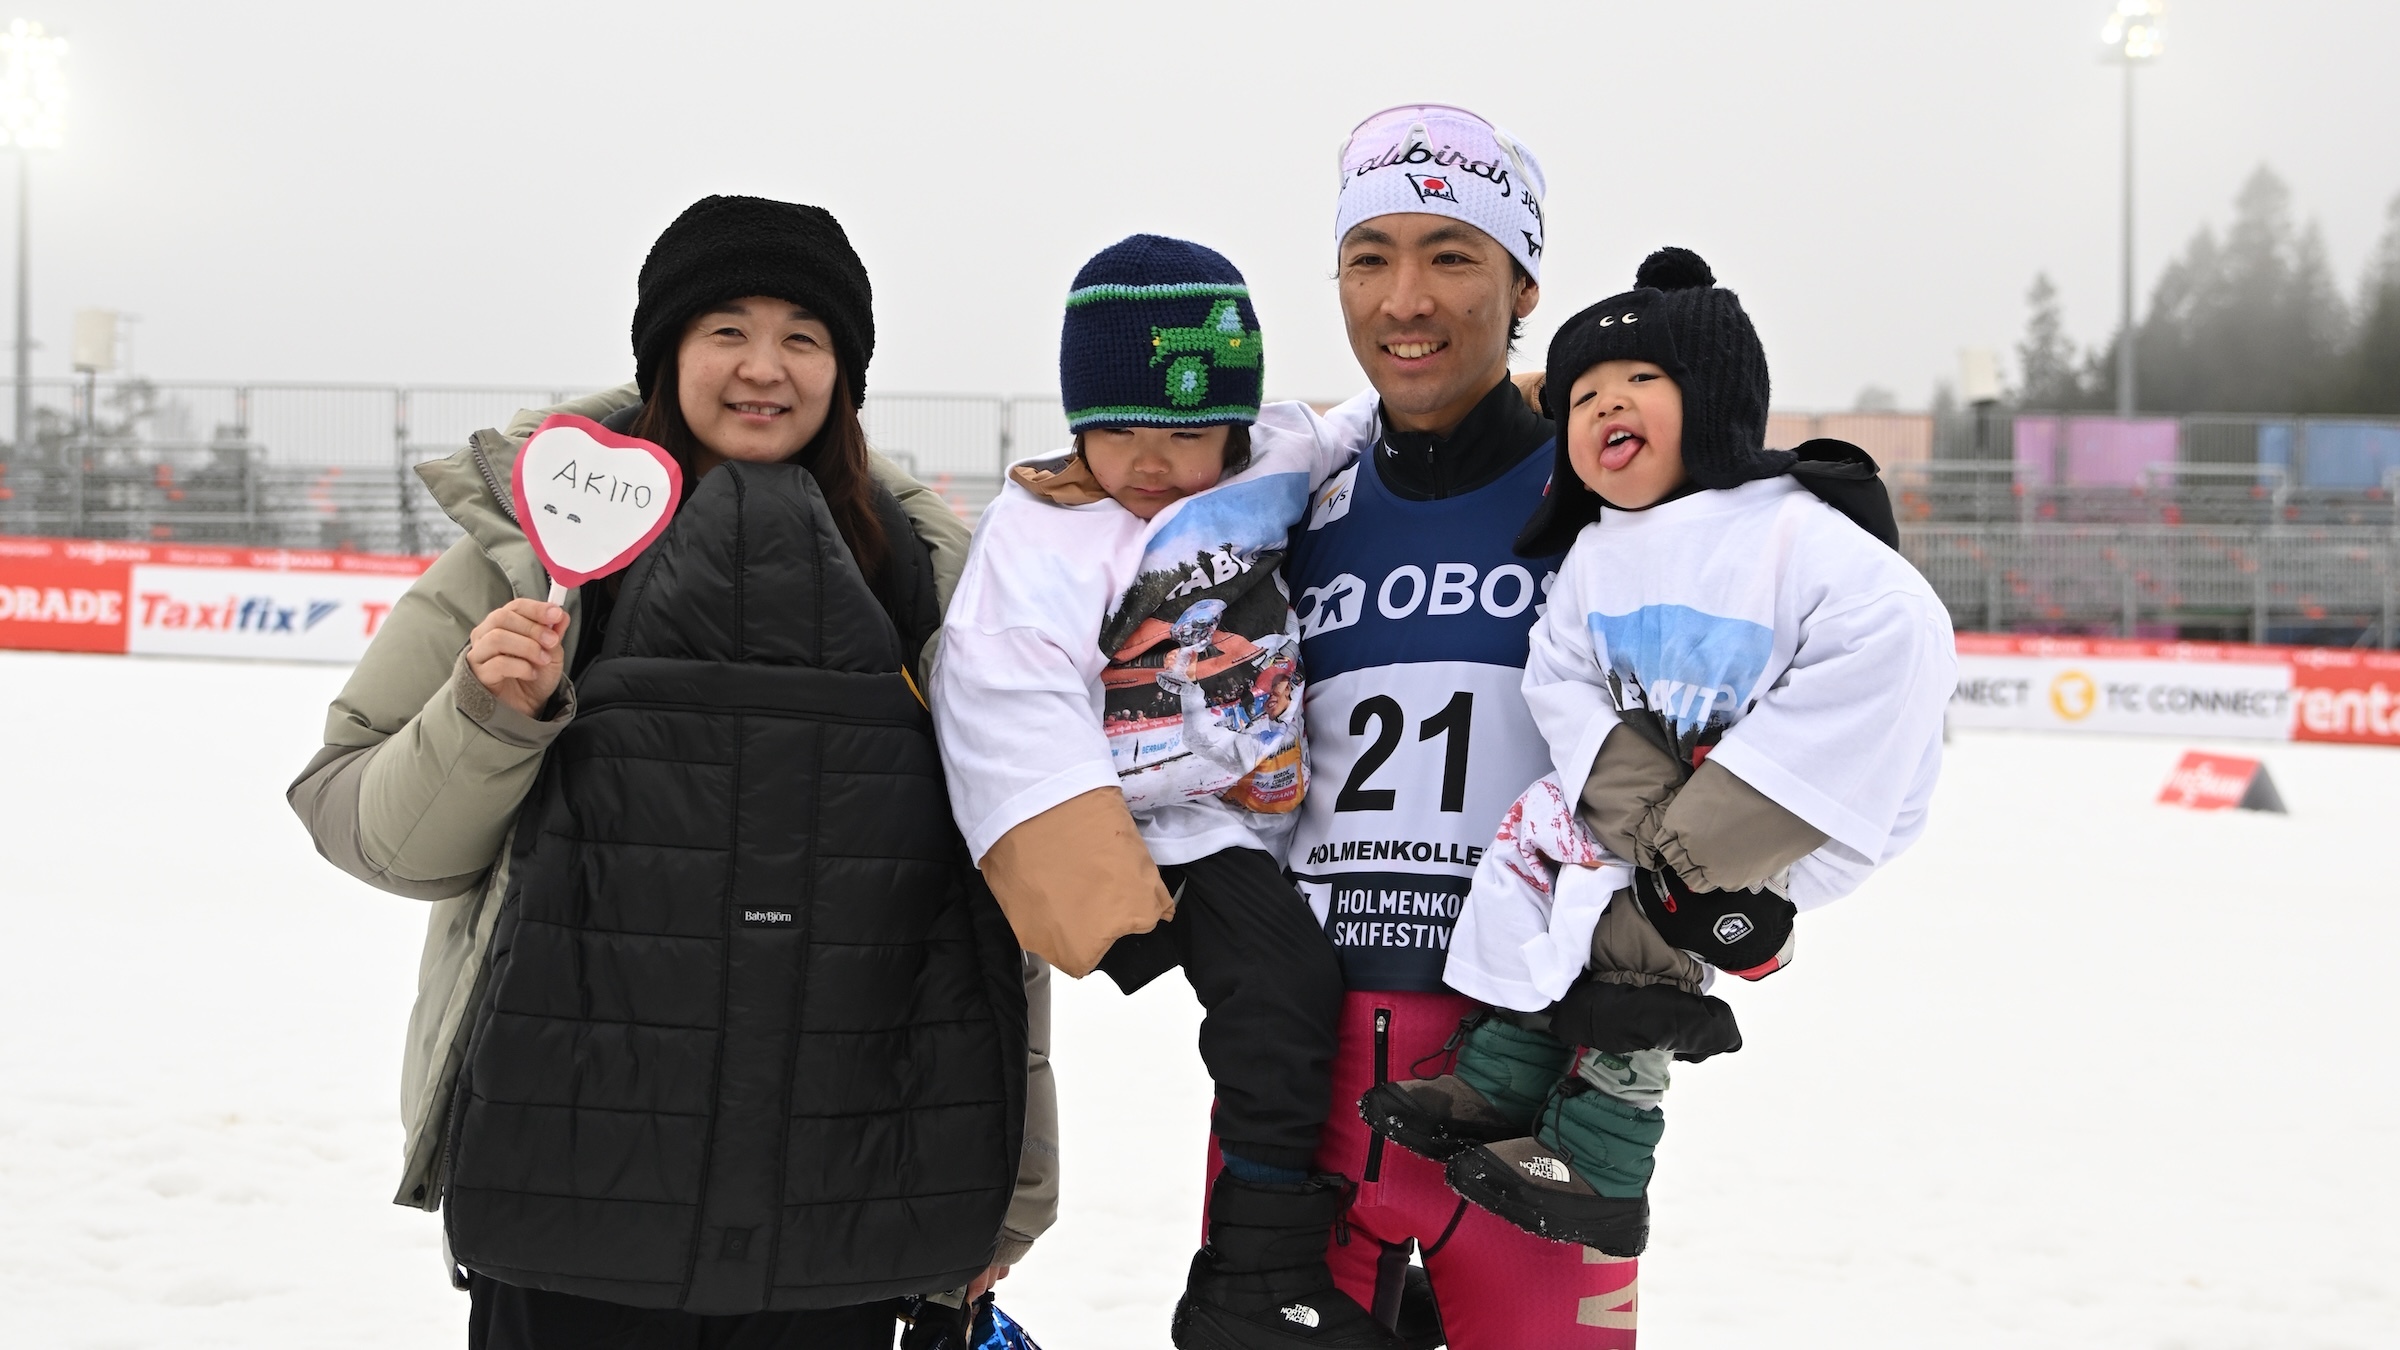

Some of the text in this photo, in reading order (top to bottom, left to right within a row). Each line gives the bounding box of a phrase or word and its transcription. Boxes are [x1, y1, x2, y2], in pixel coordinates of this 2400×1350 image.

[552, 460, 652, 509] AKITO
[139, 593, 296, 633] Taxifix
[2105, 683, 2288, 719] TC CONNECT
[1334, 691, 1473, 813] 21
[1307, 840, 1489, 866] HOLMENKOLLE
[1336, 889, 1468, 918] HOLMENKO
[744, 911, 792, 923] BabyBjörn
[1334, 921, 1450, 950] SKIFESTIV
[1519, 1161, 1552, 1172] NORTH
[1532, 1156, 1552, 1164] THE
[1530, 1169, 1553, 1180] FACE
[1280, 1307, 1308, 1318] NORTH
[1295, 1304, 1310, 1312] THE
[1285, 1313, 1305, 1324] FACE
